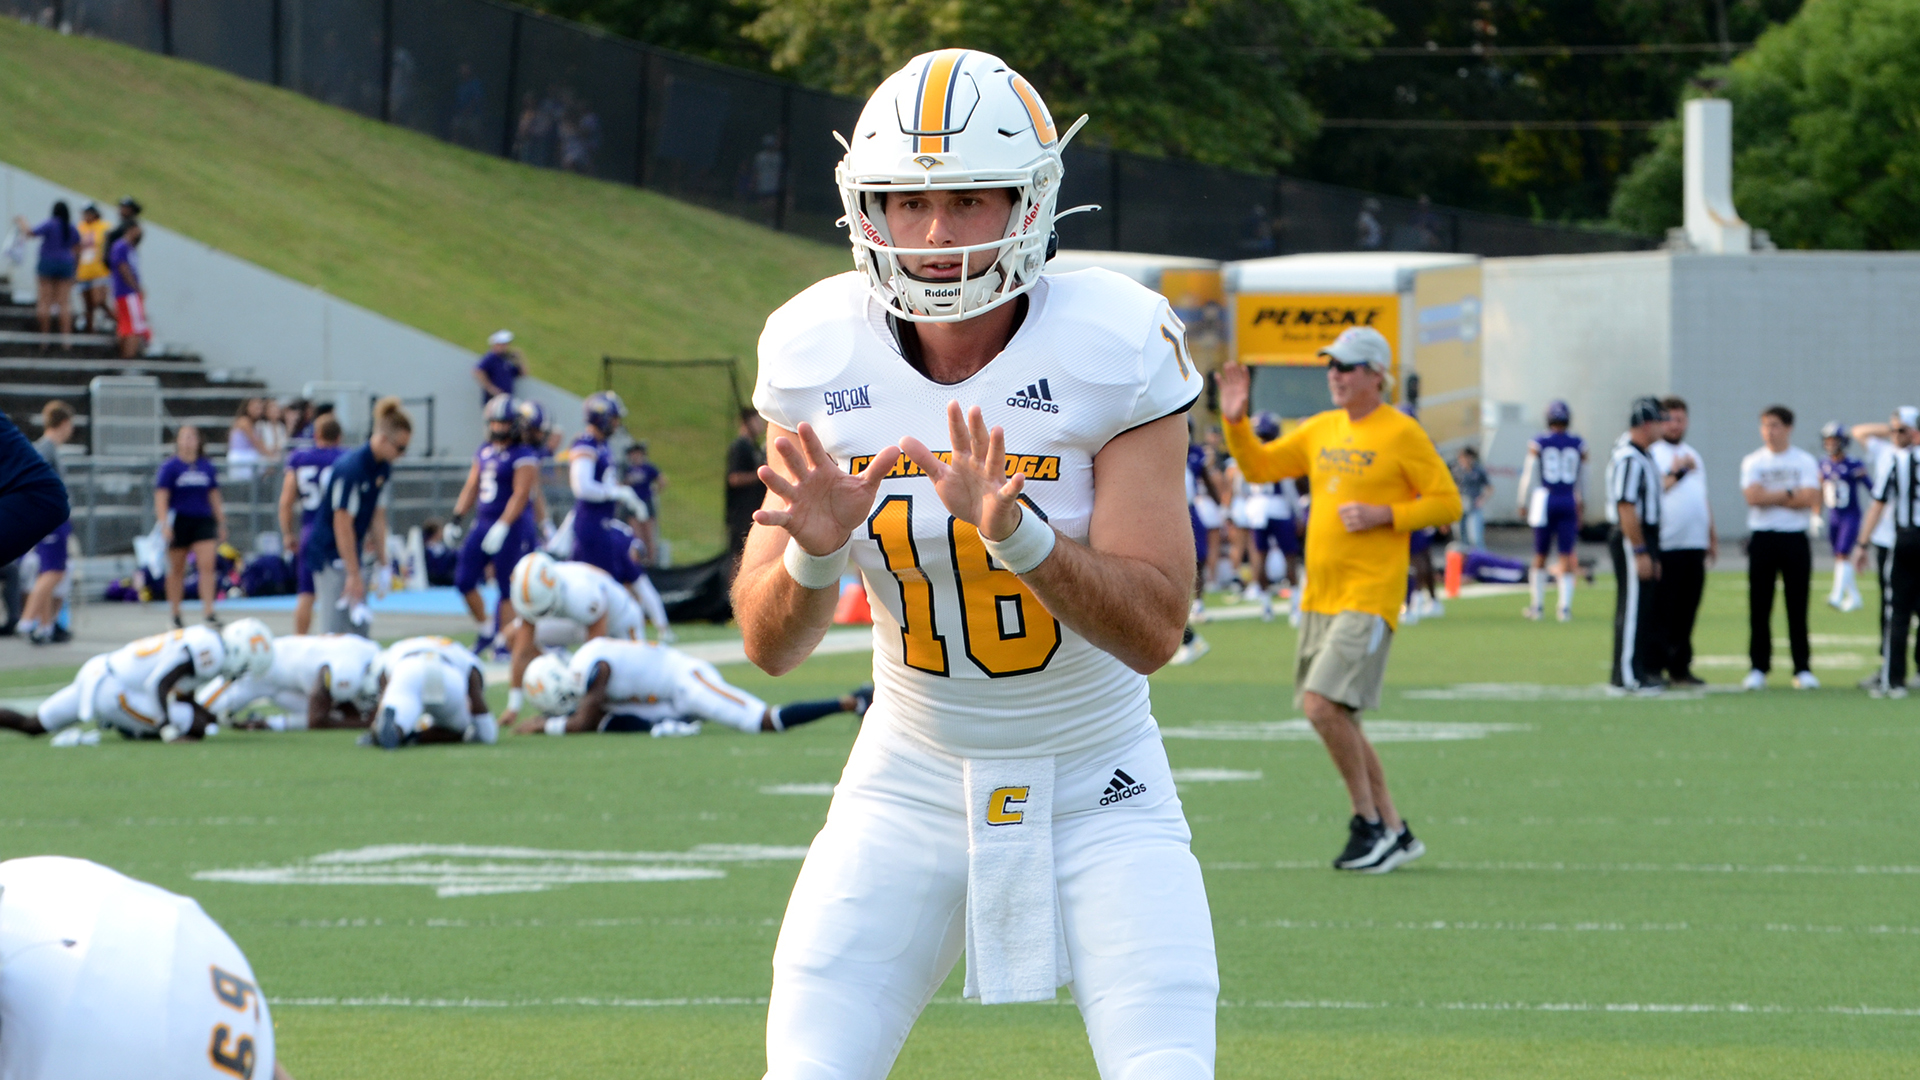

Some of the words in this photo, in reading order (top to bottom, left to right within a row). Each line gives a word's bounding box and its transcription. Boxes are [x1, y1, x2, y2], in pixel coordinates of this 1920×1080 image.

[925, 287, 961, 298] Riddell
[1253, 307, 1383, 326] PENSKE
[824, 384, 872, 415] SOCON
[1006, 396, 1059, 414] adidas
[867, 493, 1062, 679] 16
[986, 785, 1031, 827] C
[1100, 782, 1147, 806] adidas
